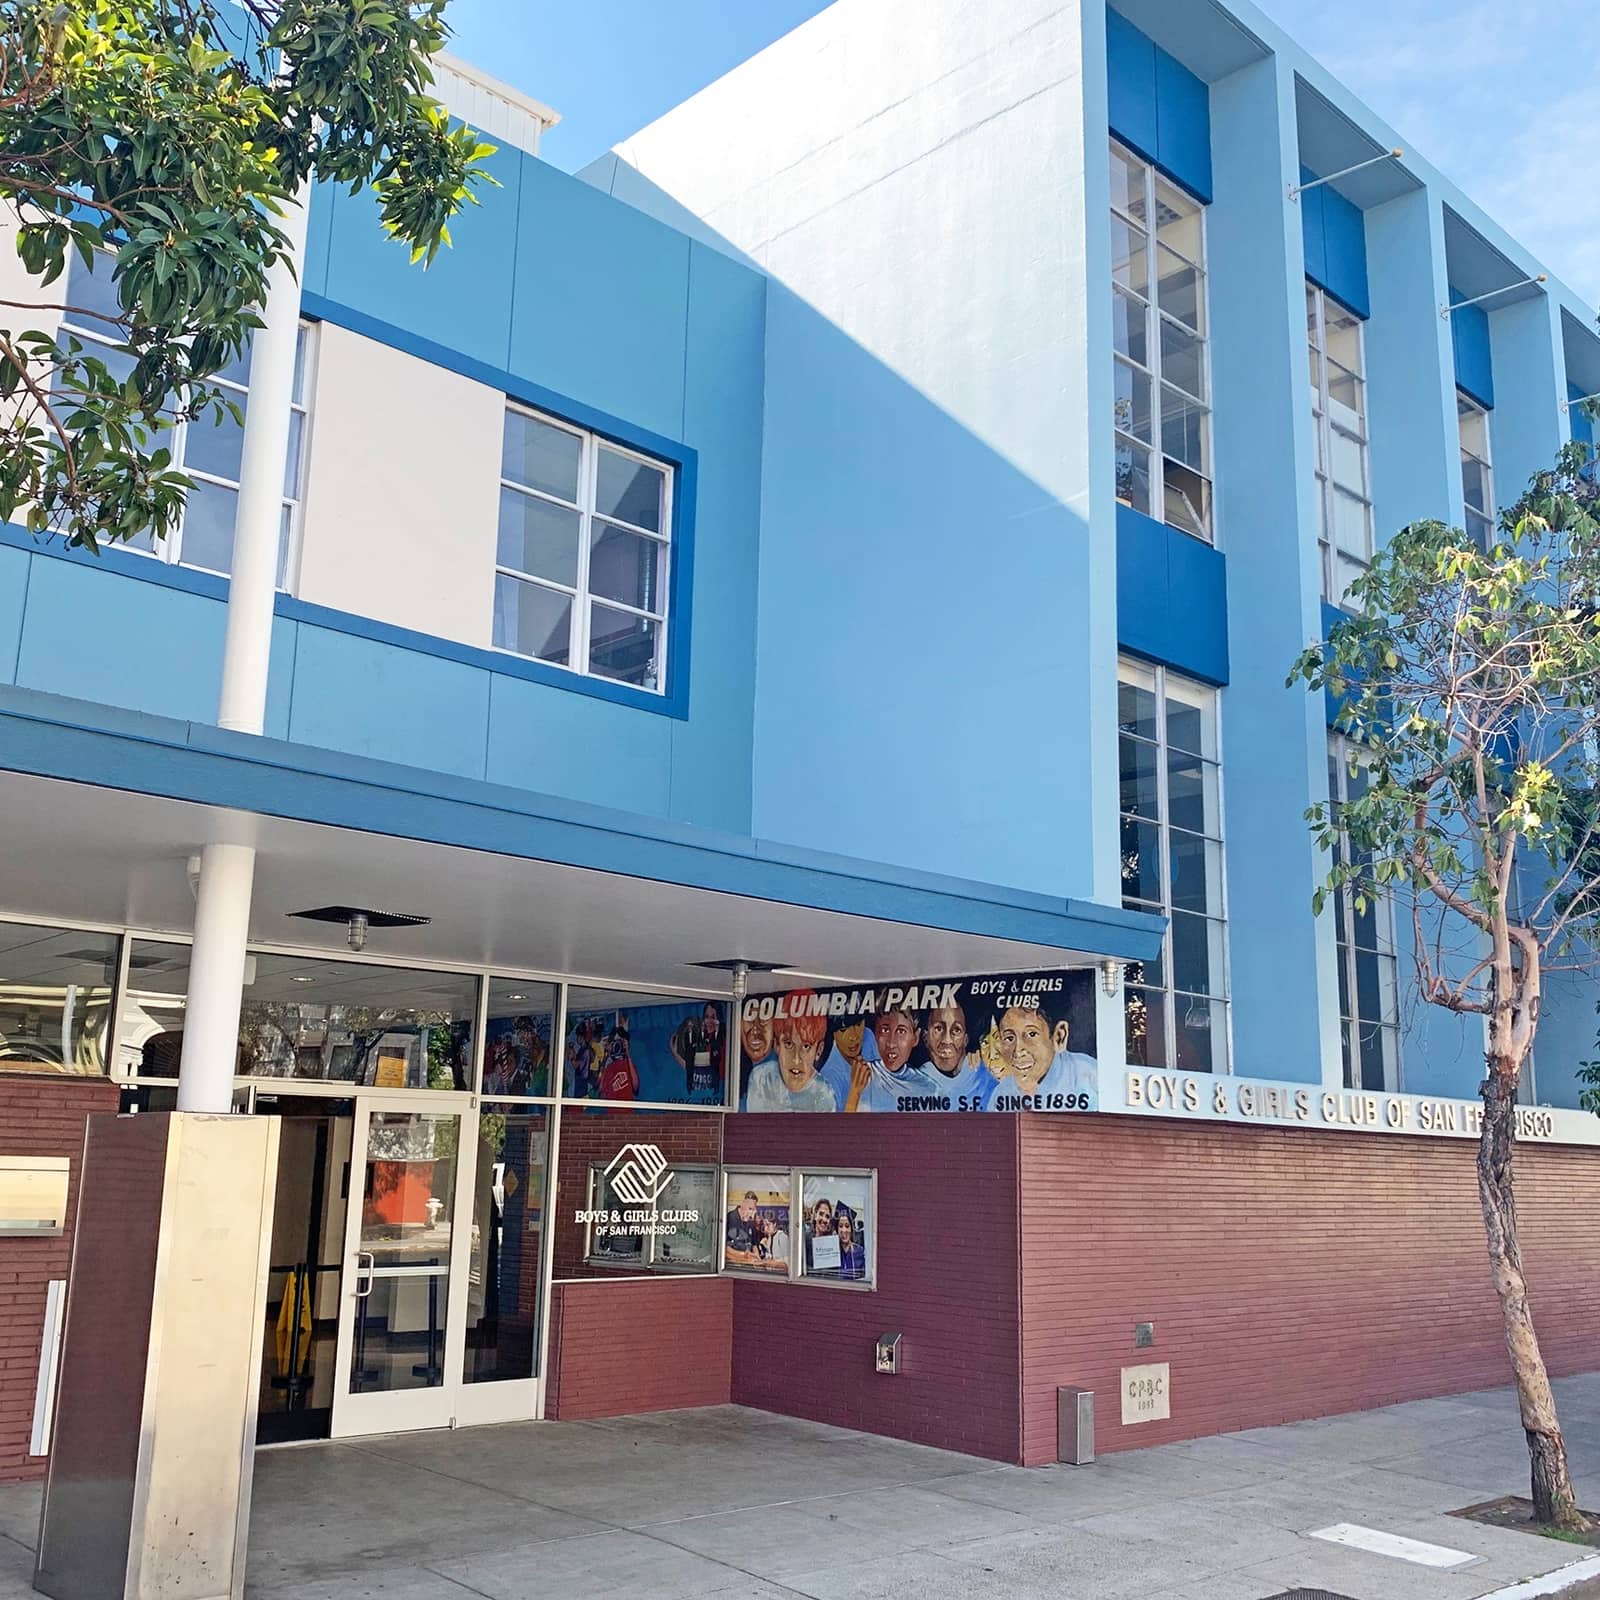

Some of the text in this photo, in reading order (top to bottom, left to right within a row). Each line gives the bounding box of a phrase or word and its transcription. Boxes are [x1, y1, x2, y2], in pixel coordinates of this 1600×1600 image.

[971, 978, 1063, 995] BOYS & GIRLS
[743, 983, 963, 1021] COLUMBIA PARK
[996, 995, 1040, 1009] CLUBS
[897, 1094, 1089, 1112] SERVING S.F. SINCE 1896
[1126, 1072, 1201, 1112] BOYS
[1214, 1081, 1227, 1114] &
[1239, 1084, 1310, 1121] GIRLS
[1322, 1092, 1377, 1126] CLUB
[1387, 1098, 1409, 1128] OF
[1420, 1101, 1457, 1132] SAN
[574, 1209, 699, 1223] BOYS & GIRLS CLUBS
[595, 1225, 677, 1236] OF SAN FRANCISCO
